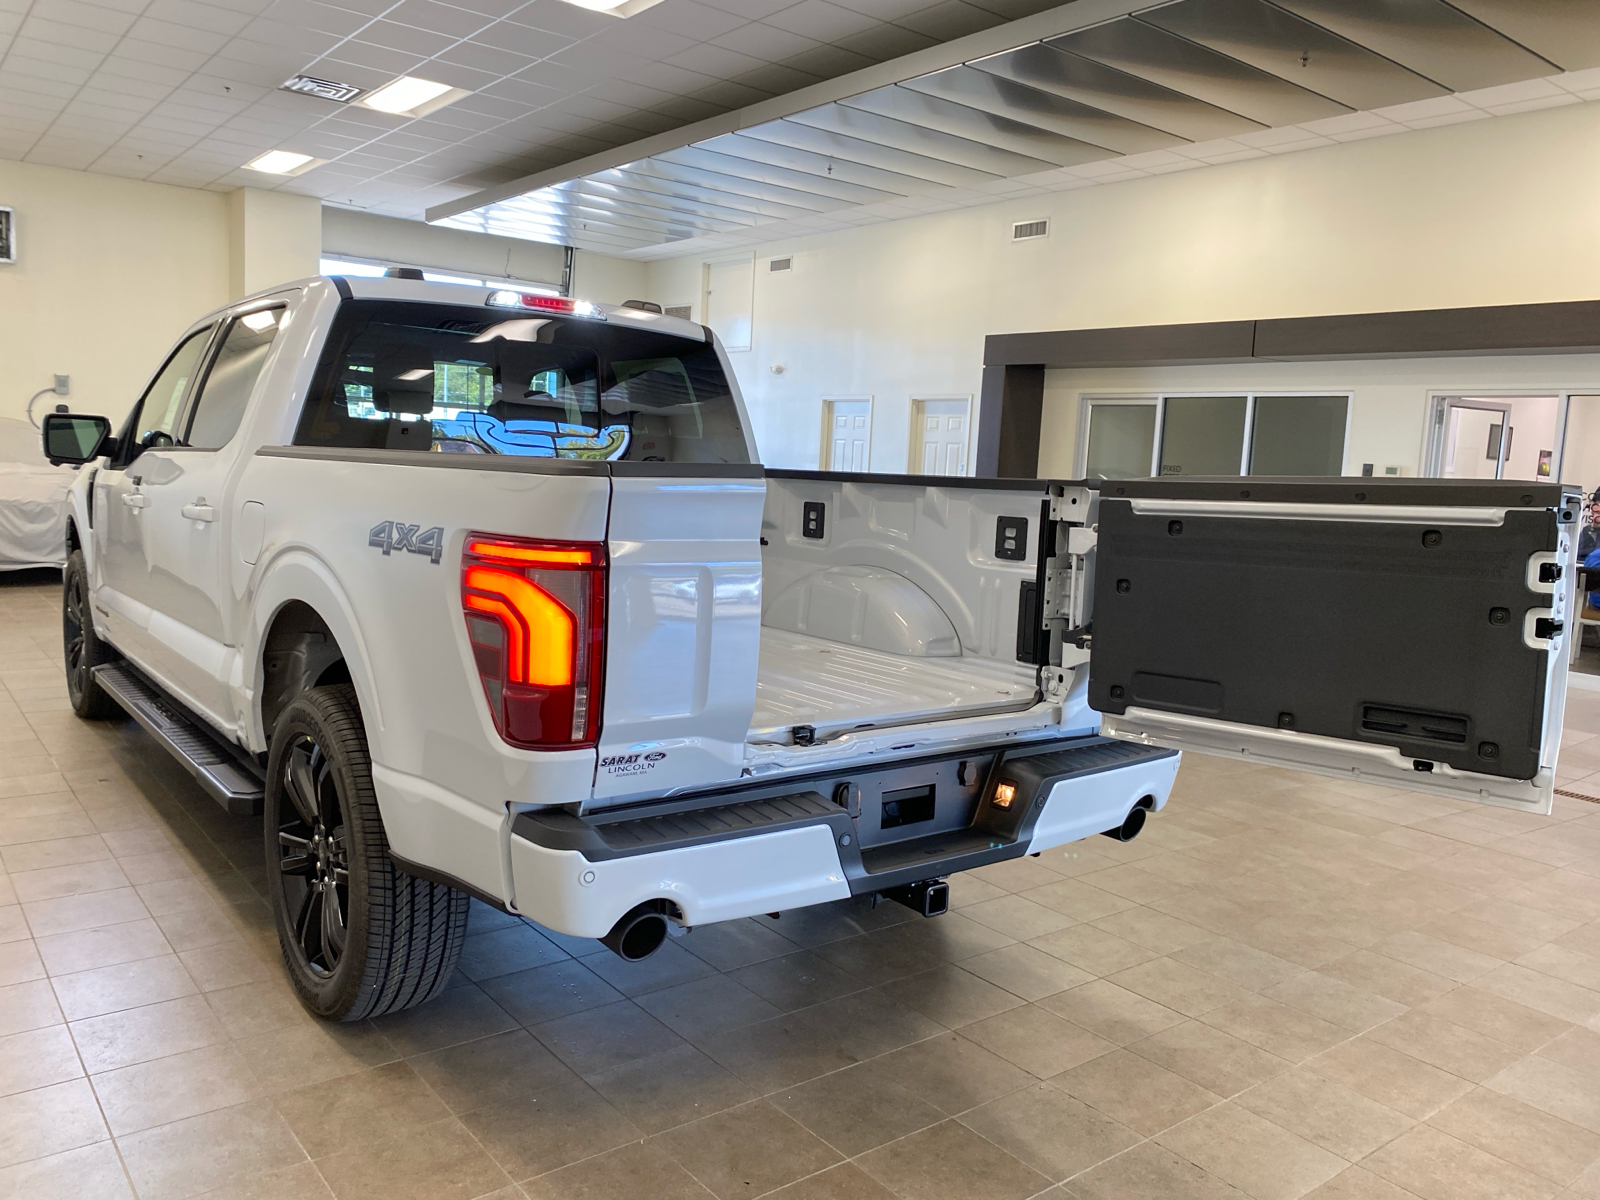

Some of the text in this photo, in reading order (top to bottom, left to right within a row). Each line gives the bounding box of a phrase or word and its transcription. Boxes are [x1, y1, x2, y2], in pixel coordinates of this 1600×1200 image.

[1163, 465, 1182, 473] FIXED
[600, 753, 642, 767] SARAT
[608, 763, 655, 774] LINCOLN
